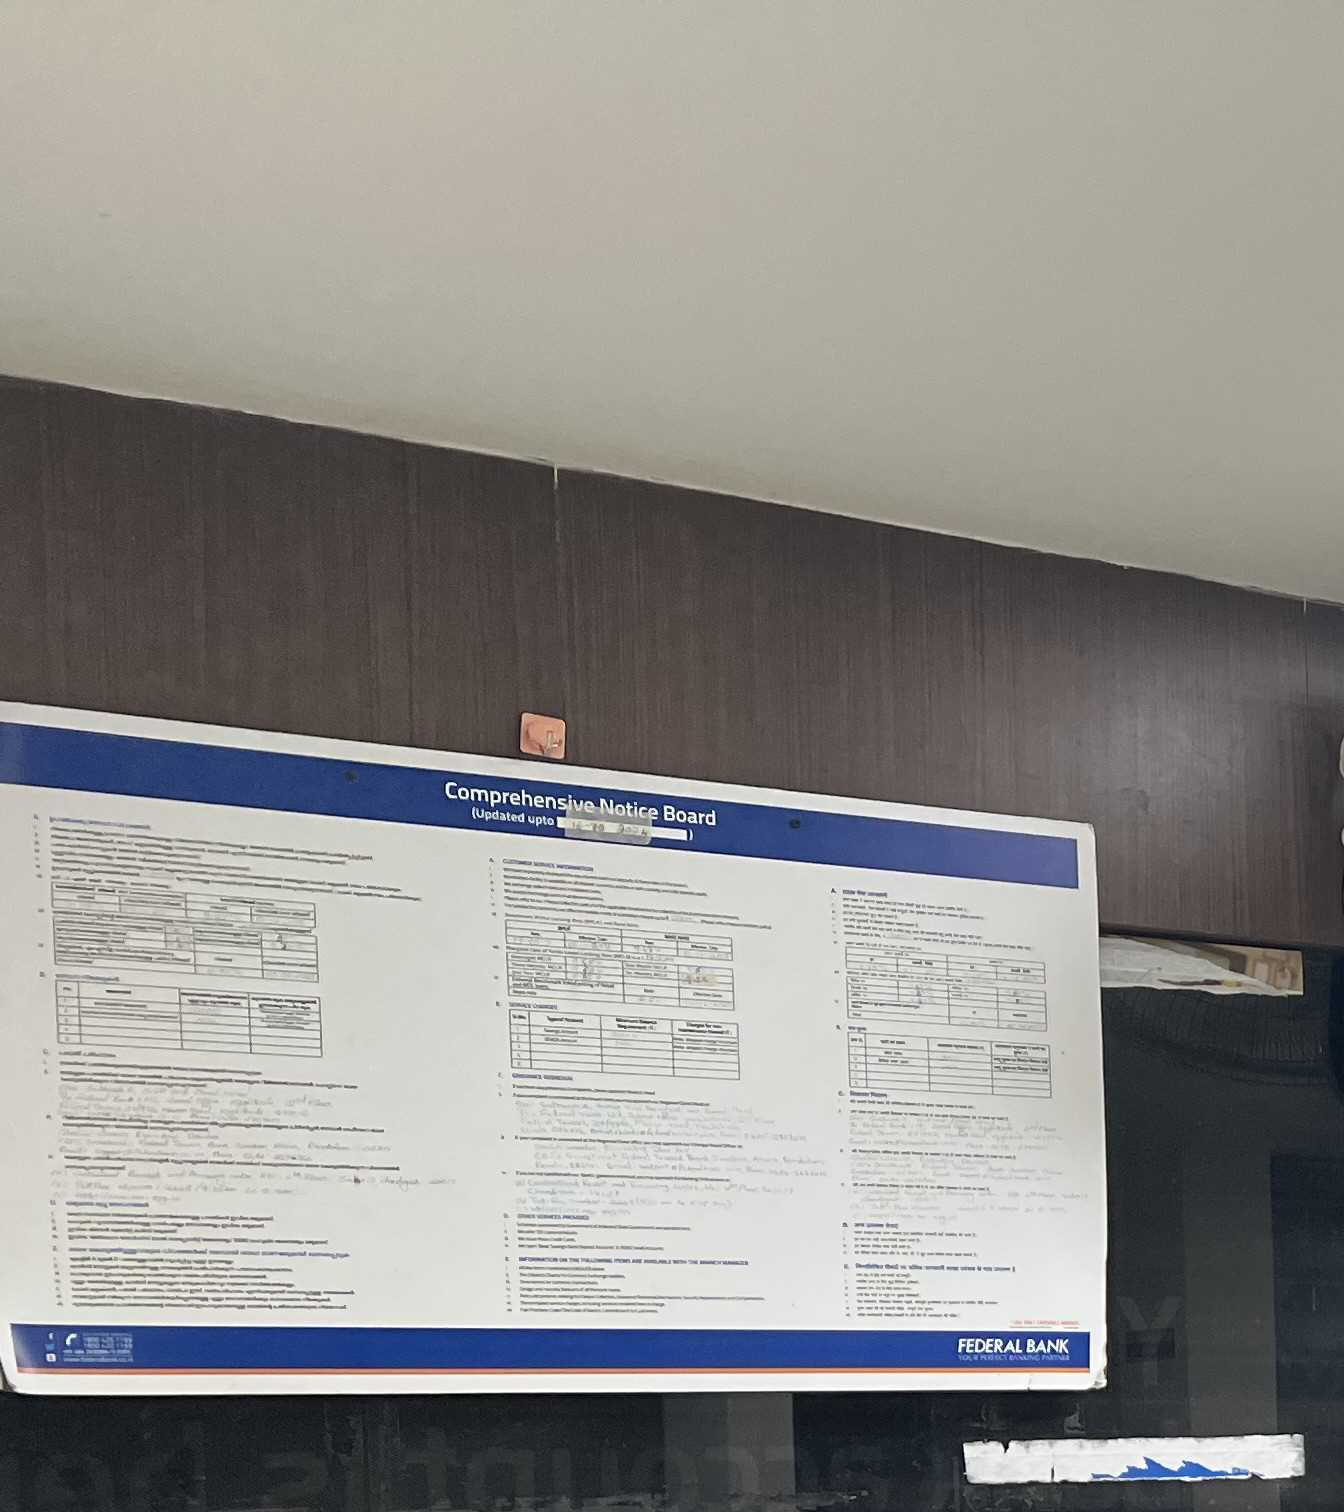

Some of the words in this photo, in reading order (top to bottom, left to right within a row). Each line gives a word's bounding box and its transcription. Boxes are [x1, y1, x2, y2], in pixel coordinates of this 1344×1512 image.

[445, 782, 595, 813] Comprehensive
[600, 798, 657, 820] Notice
[663, 804, 717, 826] Board
[472, 807, 525, 823] (Updated
[528, 812, 554, 827] upto
[957, 1338, 1022, 1353] FEDERAL
[1026, 1338, 1070, 1354] BANK
